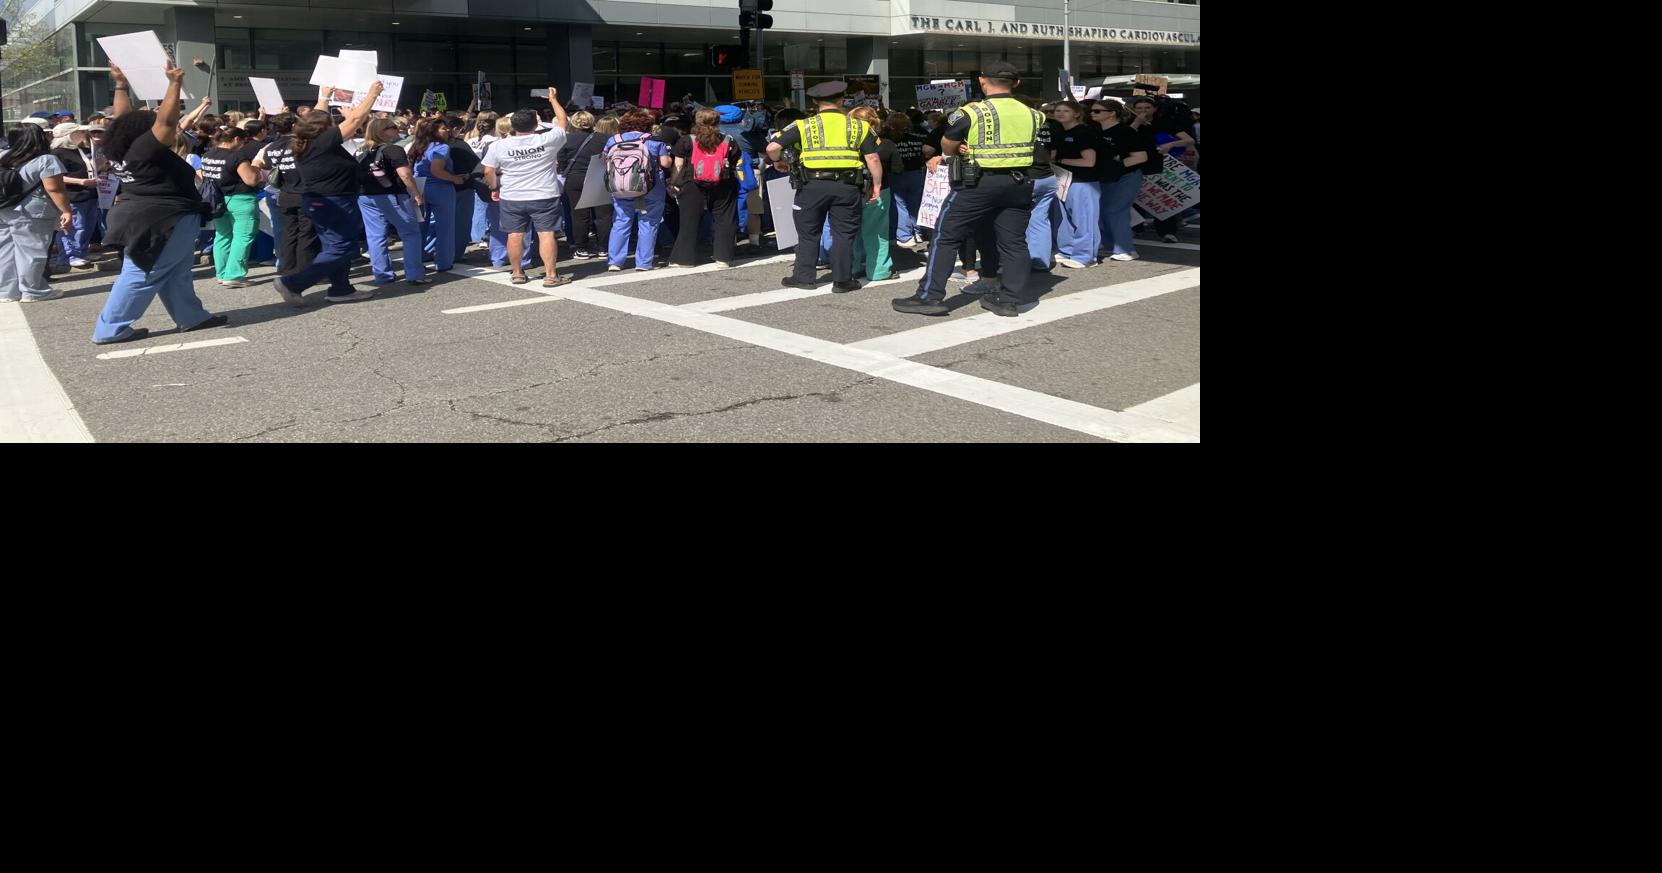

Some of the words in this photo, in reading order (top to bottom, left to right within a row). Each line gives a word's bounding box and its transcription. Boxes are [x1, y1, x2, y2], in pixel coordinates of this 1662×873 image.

[911, 16, 940, 29] THE
[945, 19, 982, 33] CARL
[1000, 22, 1028, 35] AND
[1032, 24, 1064, 37] RUTH
[1068, 26, 1117, 40] SHAPIRO
[849, 119, 858, 145] OLICE
[981, 106, 993, 142] BOSTON
[507, 145, 545, 157] UNION
[513, 153, 542, 161] STRONG
[1171, 188, 1192, 203] THE
